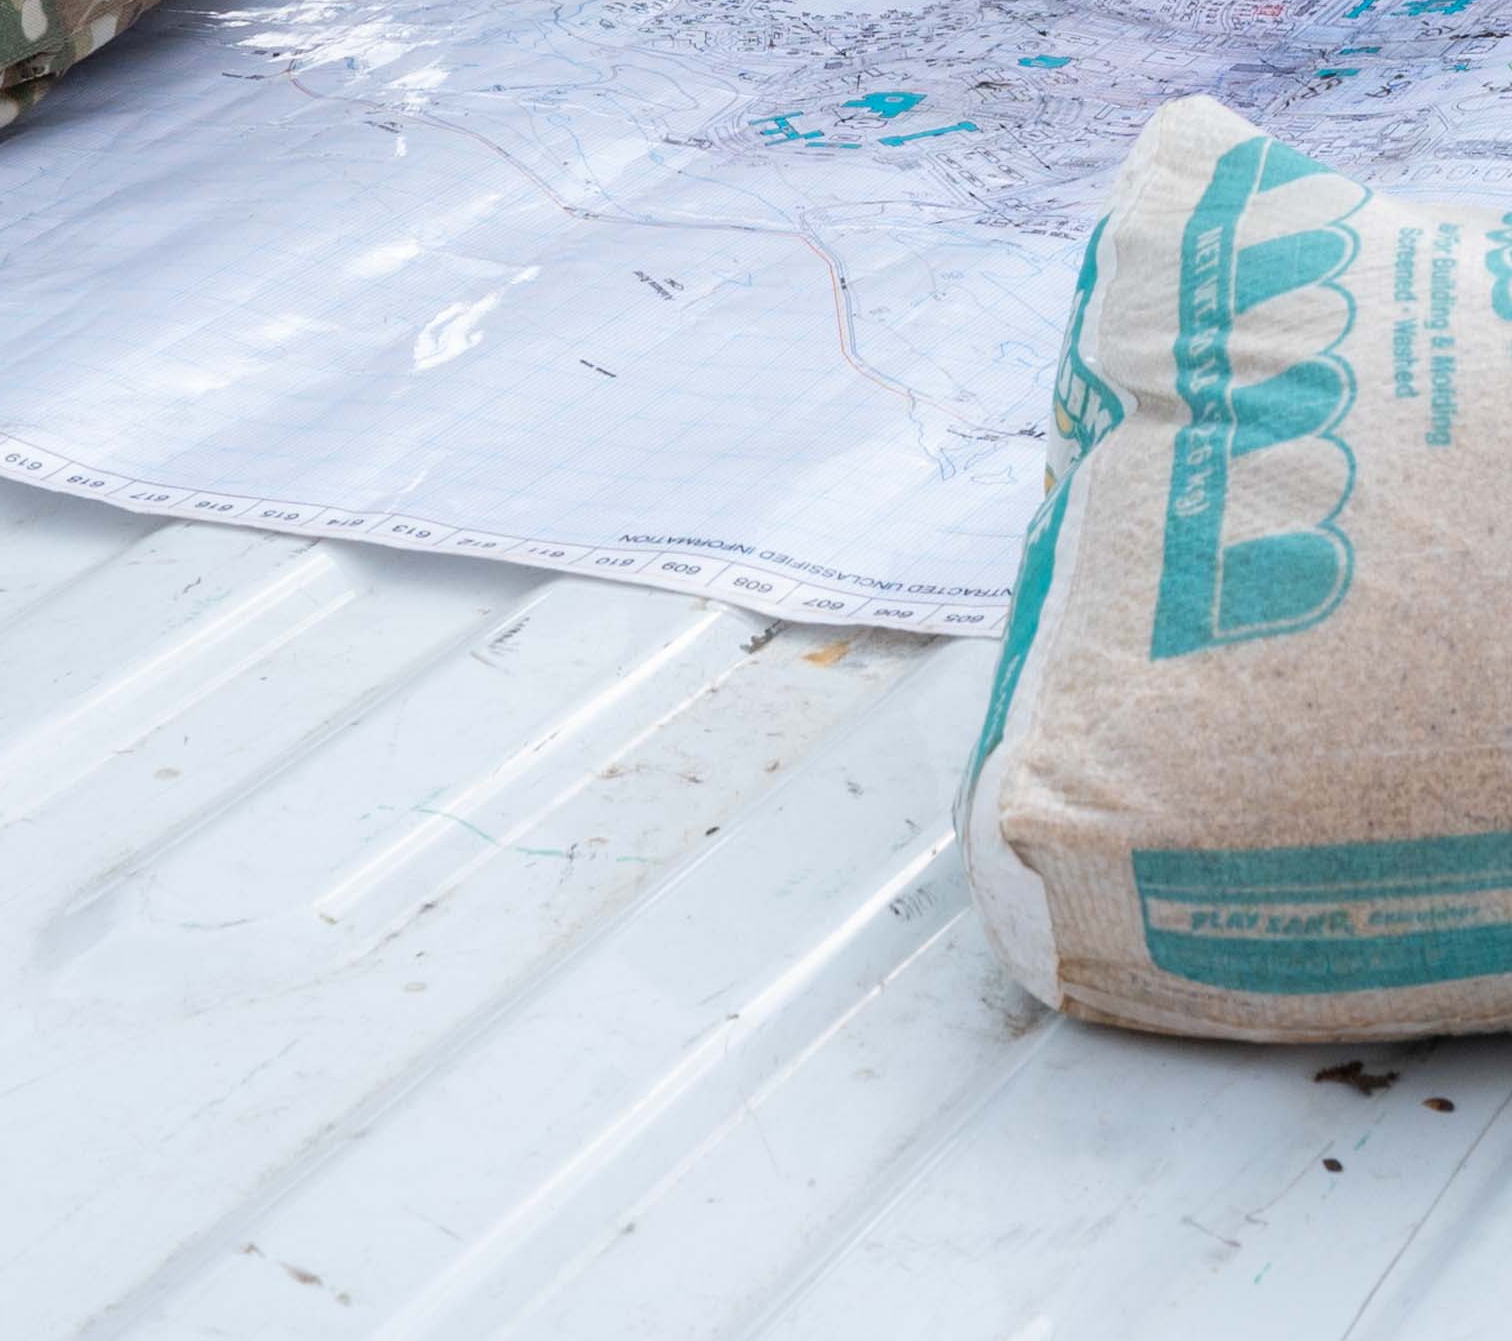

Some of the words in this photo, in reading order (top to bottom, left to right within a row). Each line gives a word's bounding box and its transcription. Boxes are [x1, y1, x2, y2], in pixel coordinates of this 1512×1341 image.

[1194, 226, 1224, 275] NET
[1394, 228, 1423, 302] Screened
[1424, 257, 1457, 330] Building
[1431, 336, 1455, 349] &
[1394, 318, 1420, 398] Washed
[1425, 355, 1458, 445] Molding
[4, 451, 44, 472] 619
[66, 474, 106, 489] 618
[130, 490, 170, 504] 617
[195, 501, 234, 513] 616
[261, 508, 300, 521] 615
[327, 517, 365, 528] 614
[391, 523, 432, 539] 613
[457, 536, 497, 549] 612
[619, 533, 756, 556] INFORMATION
[526, 545, 566, 559] 611
[595, 555, 636, 568] 610
[660, 559, 703, 576] 609
[758, 549, 903, 592] UNCLASSIFIED
[731, 576, 774, 595] 608
[908, 581, 1012, 598] NTRACTED
[803, 596, 845, 611] 607
[872, 605, 915, 620] 606
[942, 611, 985, 625] 605
